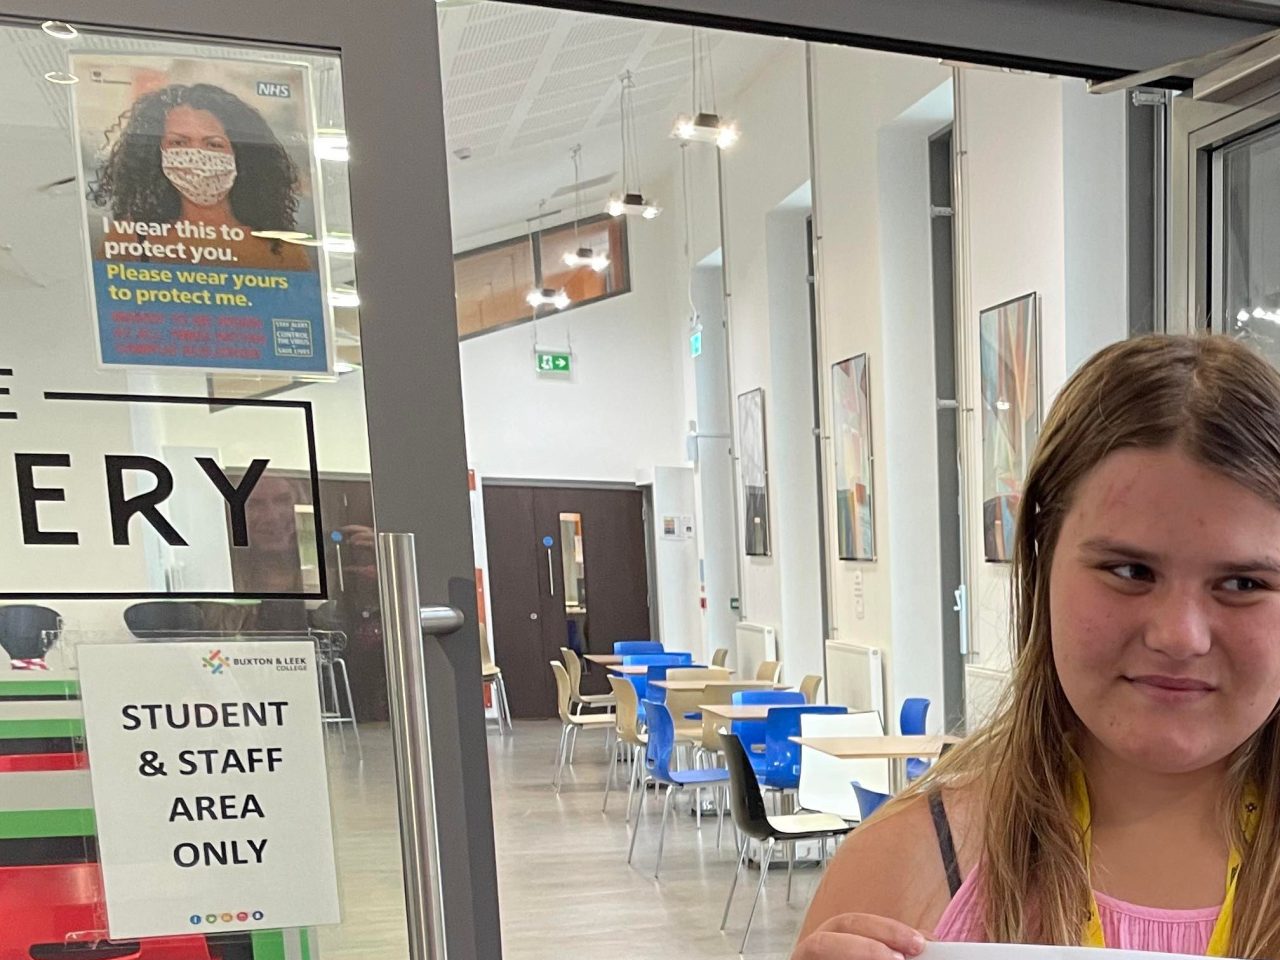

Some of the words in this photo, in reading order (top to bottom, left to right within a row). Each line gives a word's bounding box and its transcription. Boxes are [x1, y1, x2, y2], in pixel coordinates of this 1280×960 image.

[258, 83, 289, 96] NHS
[102, 217, 109, 233] I
[114, 221, 175, 237] wear
[175, 220, 216, 240] this
[220, 224, 245, 241] to
[104, 241, 186, 259] protect
[190, 246, 239, 264] you.
[106, 264, 172, 283] Please
[176, 270, 229, 285] wear
[232, 274, 289, 290] yours
[108, 285, 132, 300] to
[136, 287, 211, 305] protect
[215, 292, 253, 307] me.
[234, 658, 273, 666] BUXTON
[285, 657, 307, 665] LEEK
[121, 701, 289, 730] STUDENT
[139, 750, 168, 777] &
[178, 747, 283, 775] STAFF
[169, 794, 265, 822] AREA
[173, 839, 268, 868] ONLY
